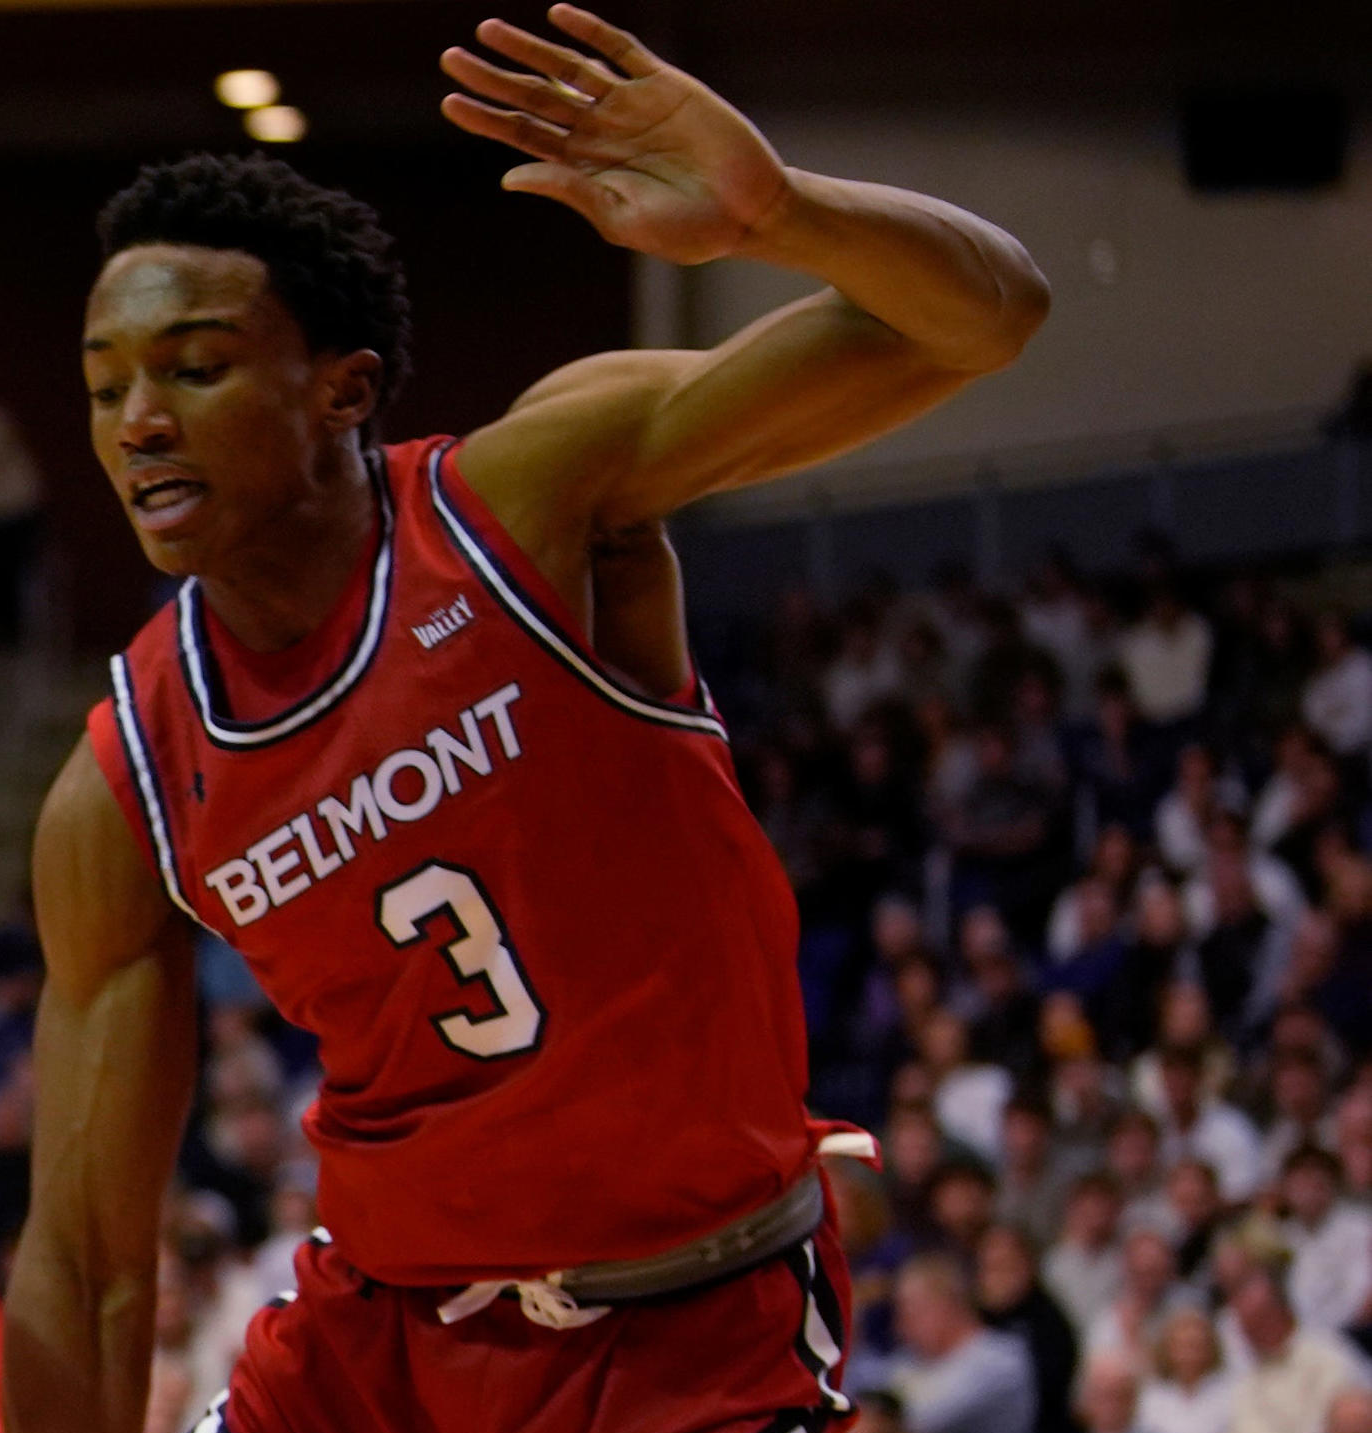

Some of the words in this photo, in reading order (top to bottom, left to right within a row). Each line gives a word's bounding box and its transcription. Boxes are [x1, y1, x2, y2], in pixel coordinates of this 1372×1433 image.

[411, 593, 474, 649] VALLEY
[206, 683, 522, 928] BELMONT
[376, 858, 547, 1062] 3
